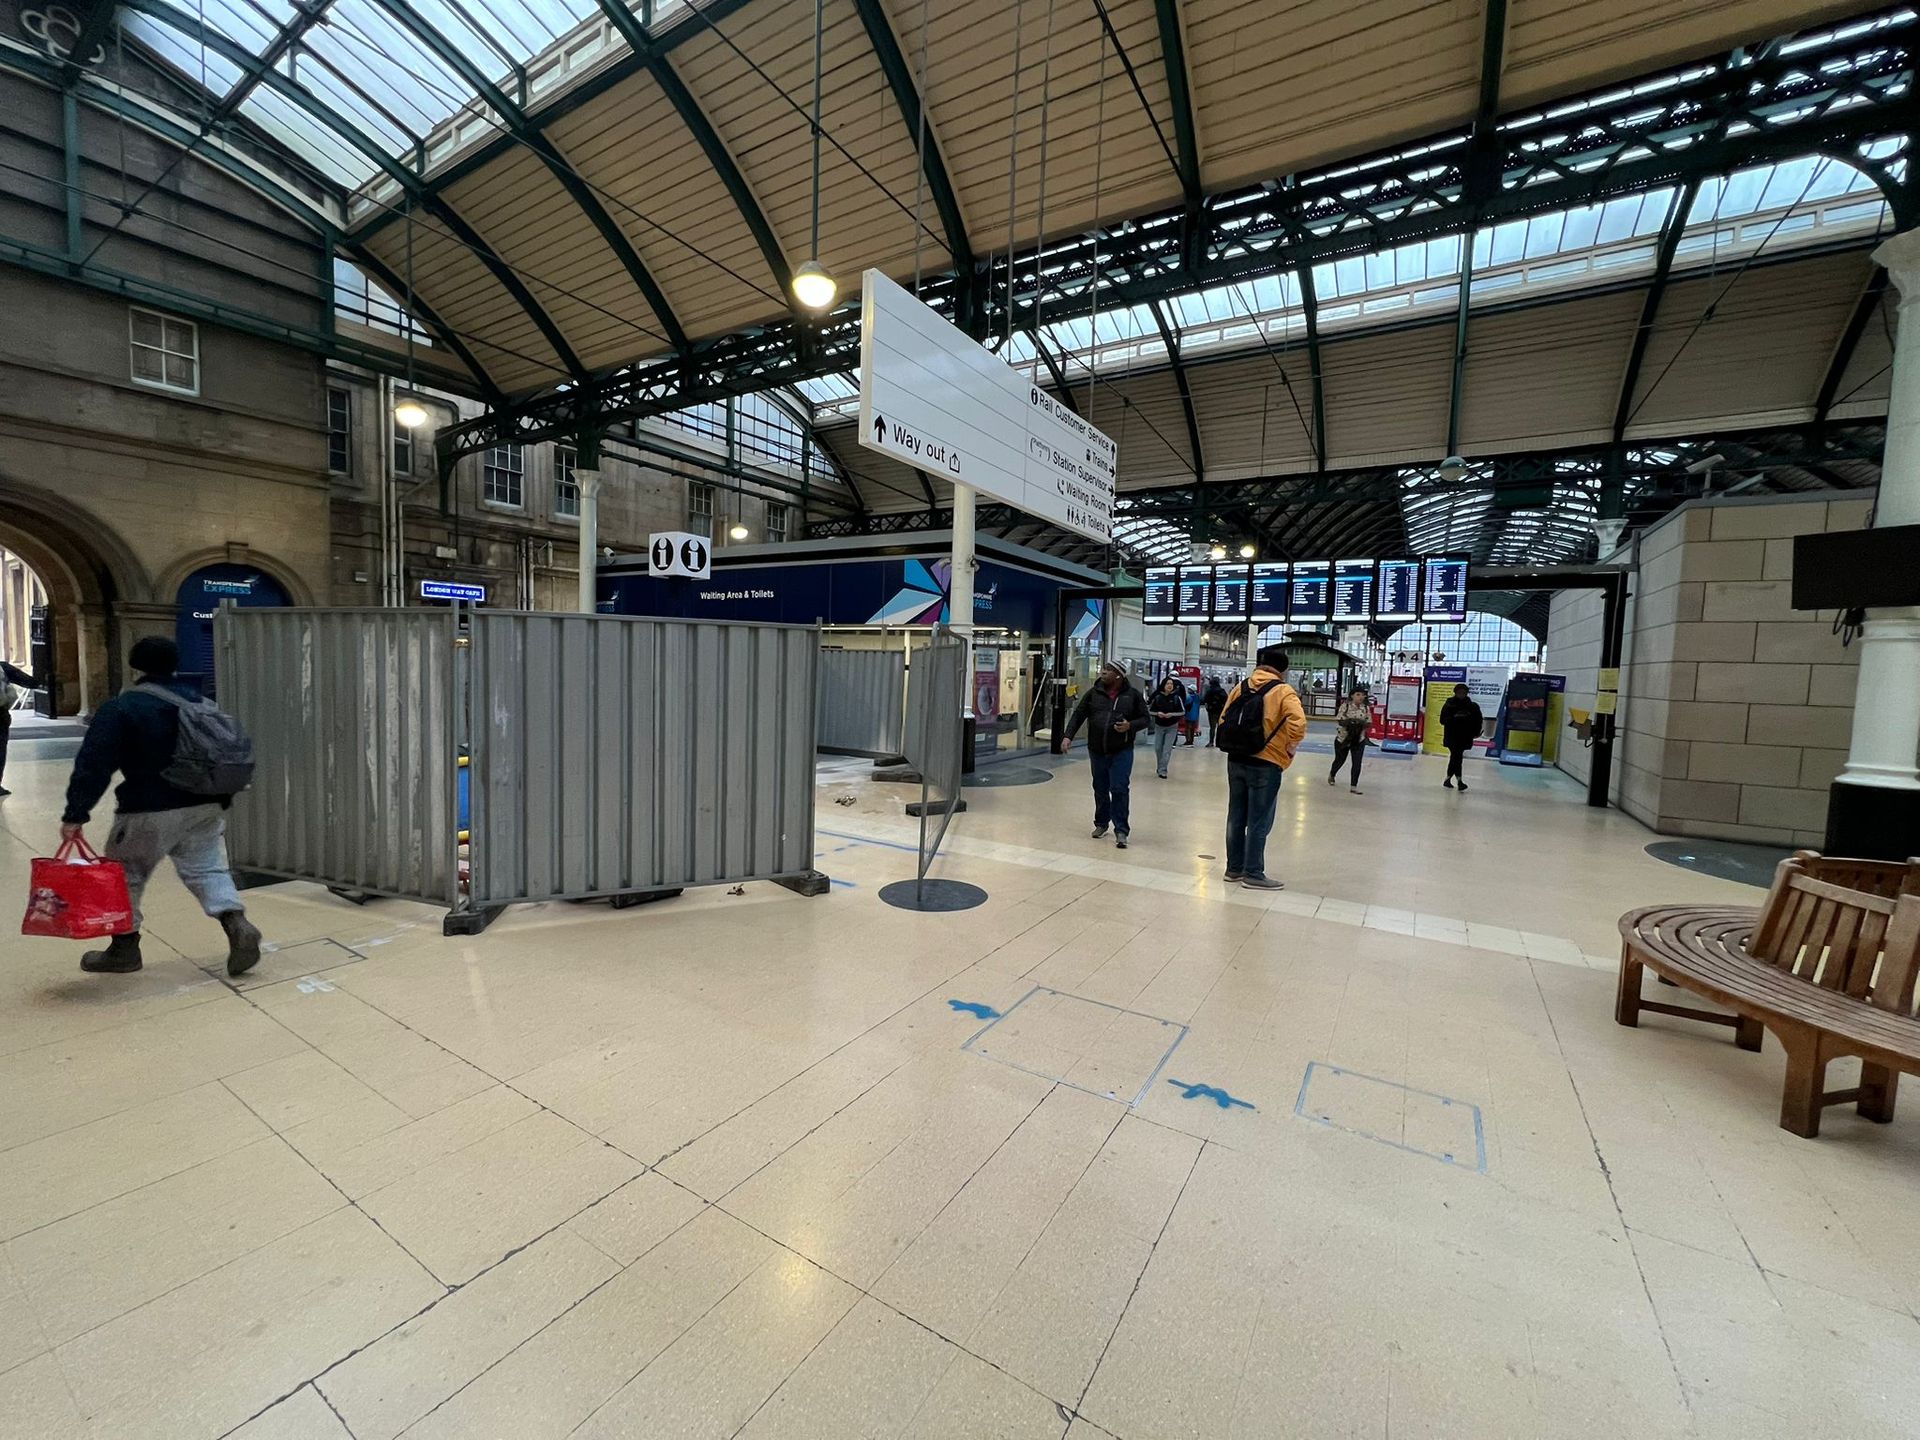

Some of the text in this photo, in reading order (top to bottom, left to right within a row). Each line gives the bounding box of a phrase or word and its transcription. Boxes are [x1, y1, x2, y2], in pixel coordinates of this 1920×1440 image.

[1039, 393, 1053, 414] Rail
[1055, 405, 1086, 435] Customer
[1087, 427, 1109, 451] Service
[893, 423, 945, 463] Way out
[1092, 451, 1108, 472] Trains
[1053, 451, 1107, 492] Station Supervisor
[1066, 481, 1107, 512] Waiting Room
[1087, 514, 1105, 533] Toilets
[203, 585, 252, 595] EXPRESS
[700, 589, 774, 601] Waiting Area & Toilets
[974, 599, 993, 609] PRESS
[192, 611, 214, 619] Cust
[1411, 653, 1419, 662] 4
